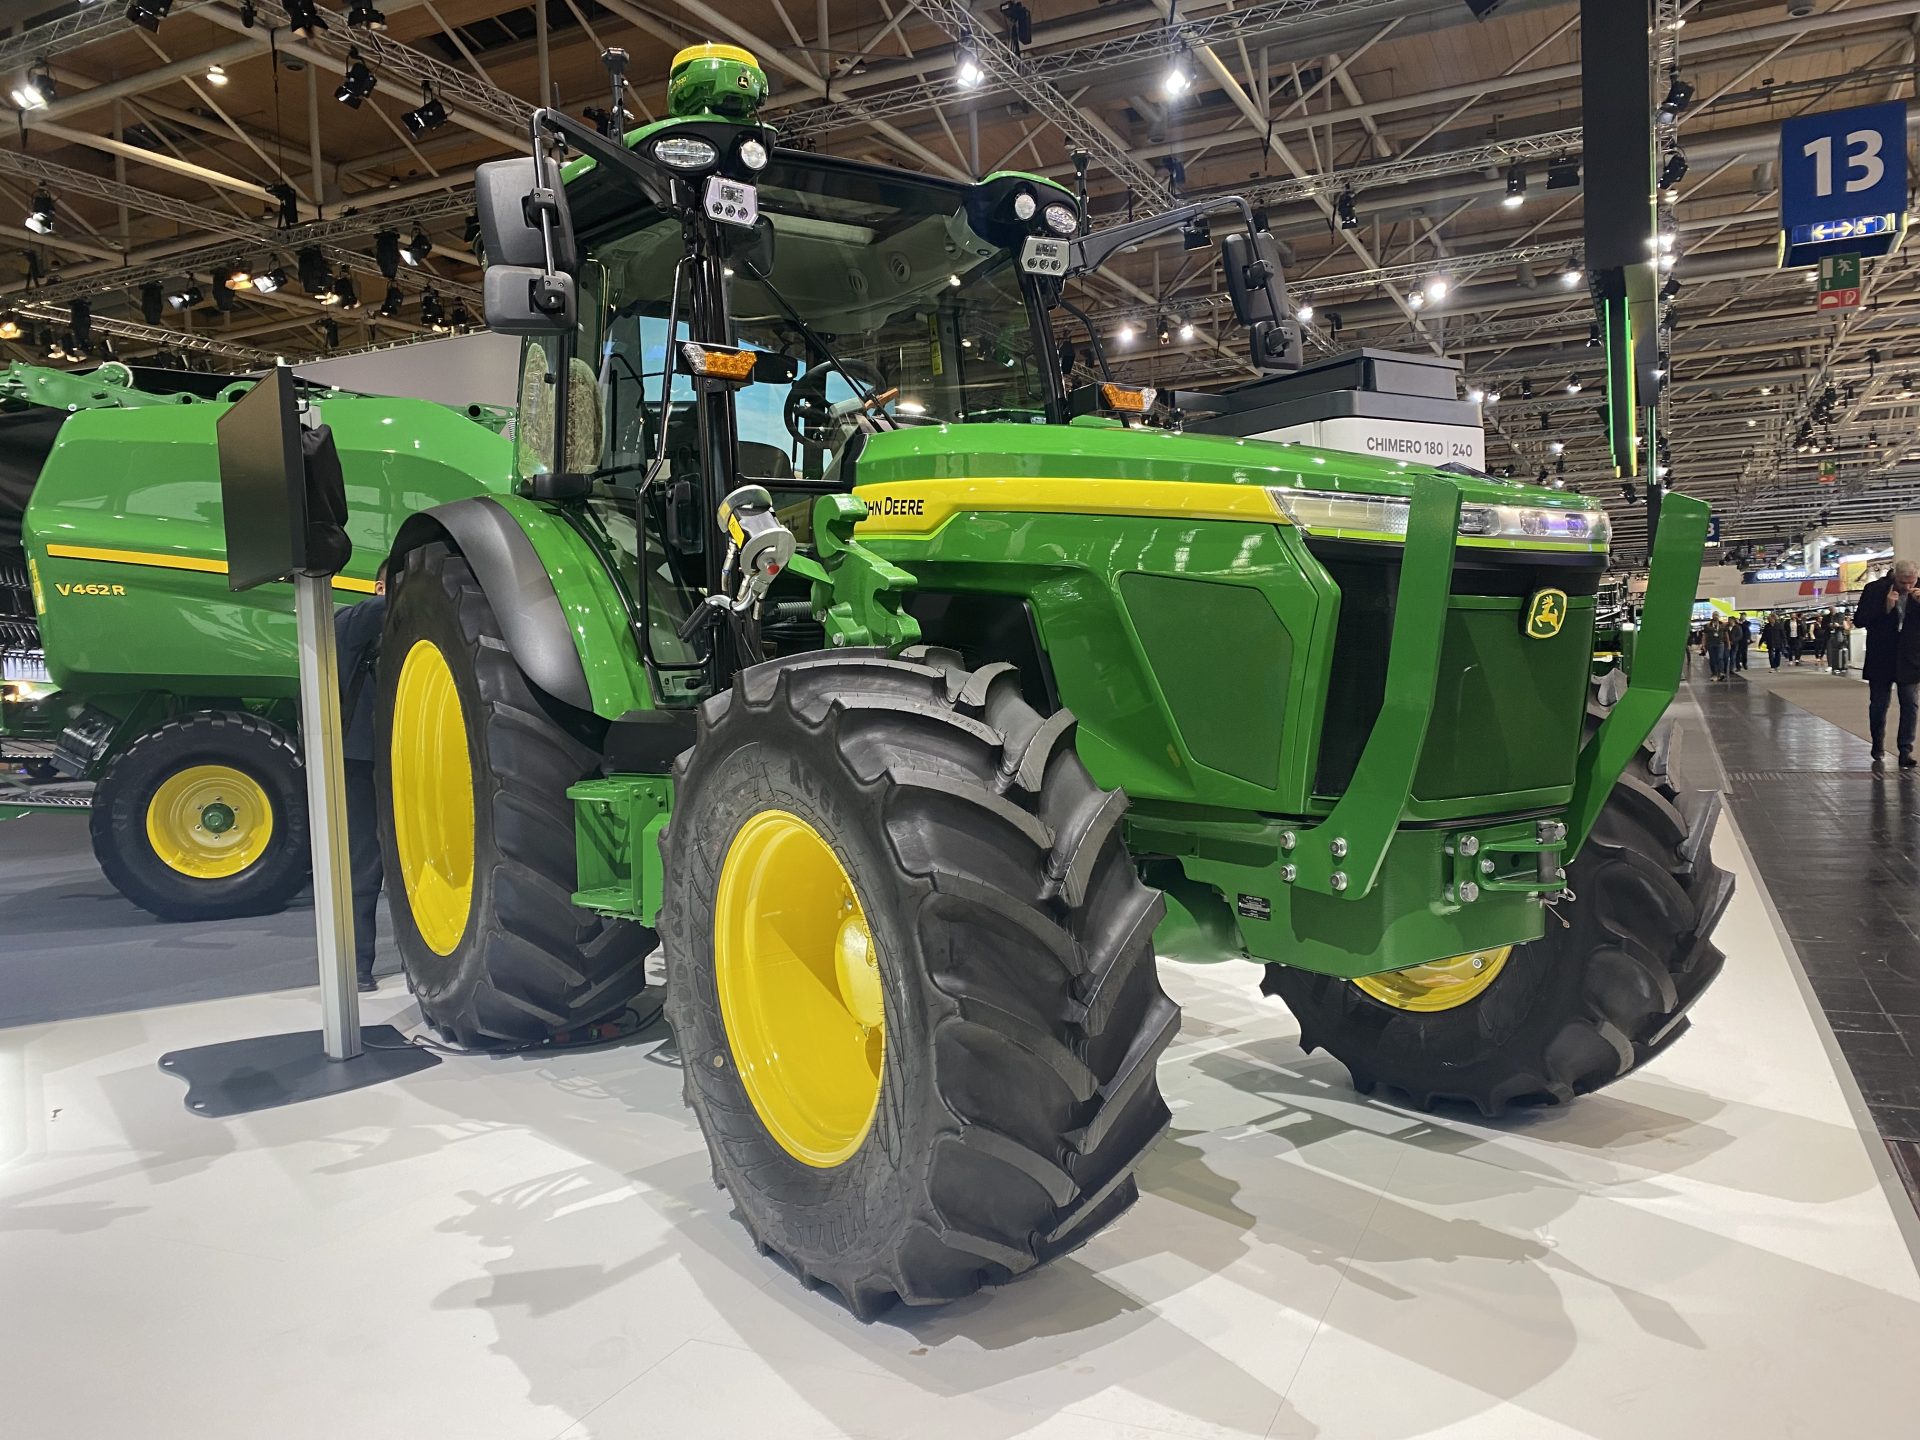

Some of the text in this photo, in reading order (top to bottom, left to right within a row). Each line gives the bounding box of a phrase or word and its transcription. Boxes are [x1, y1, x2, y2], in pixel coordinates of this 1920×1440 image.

[1803, 129, 1885, 197] 13
[1366, 437, 1473, 457] CHIMERO 180 240
[884, 496, 925, 516] DEERE
[1706, 522, 1715, 537] 3
[1757, 572, 1784, 580] GROUP
